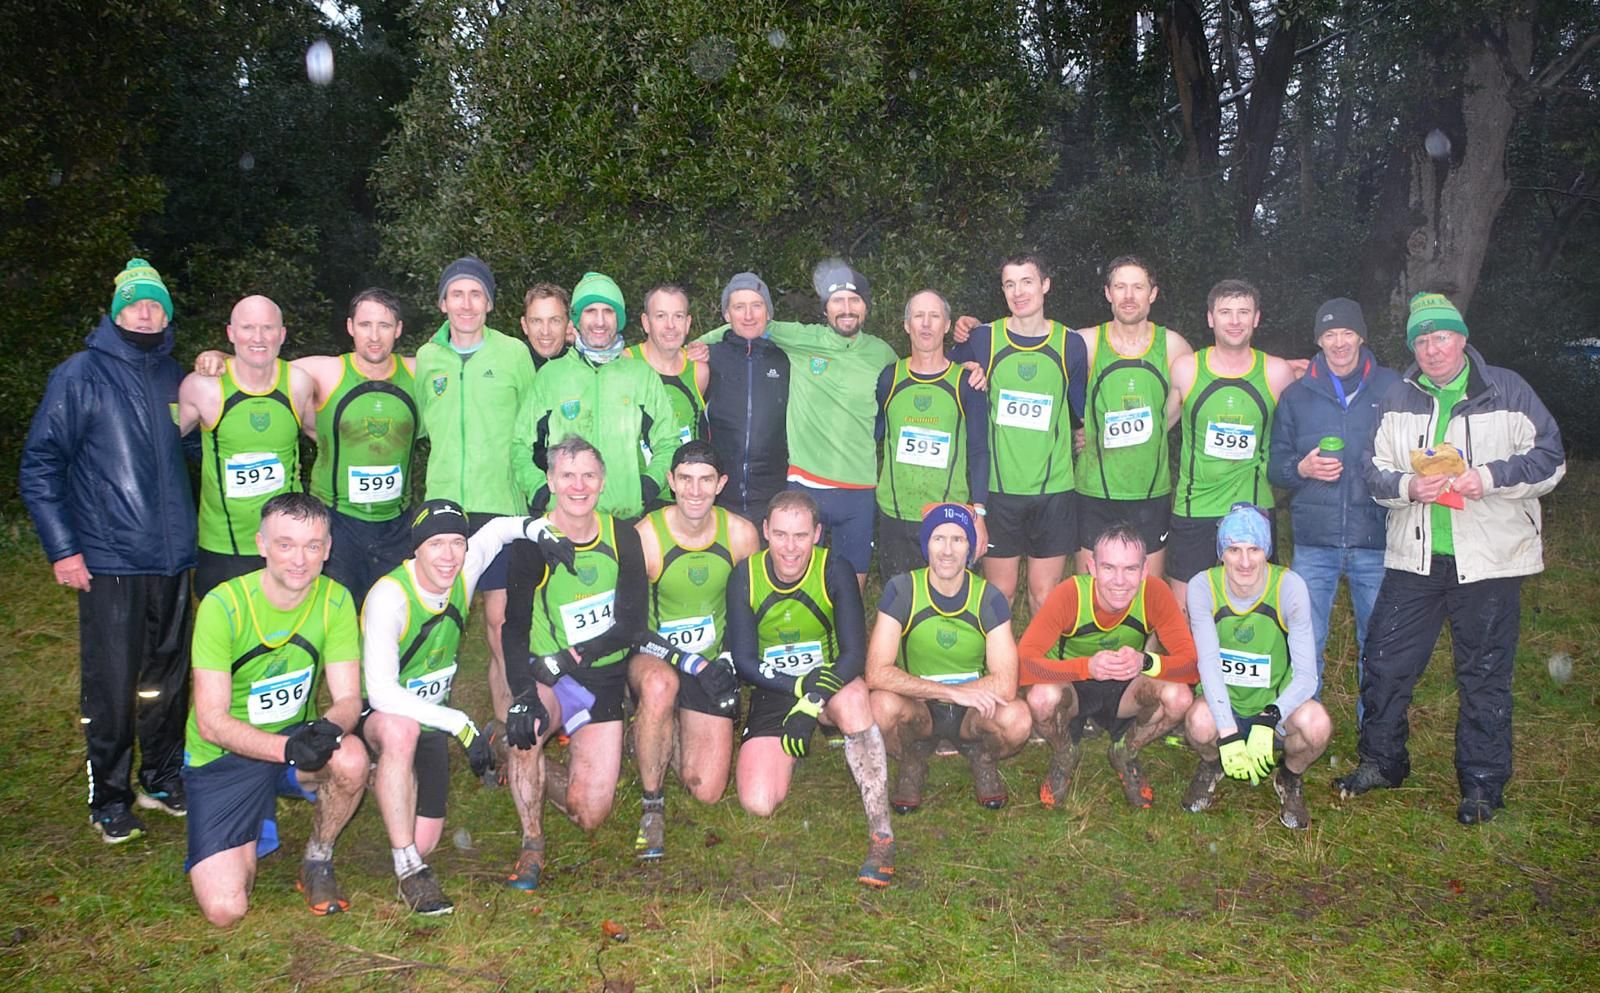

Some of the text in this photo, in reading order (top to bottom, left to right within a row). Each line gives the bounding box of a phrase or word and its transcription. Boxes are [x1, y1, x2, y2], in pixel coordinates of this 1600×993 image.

[1007, 401, 1042, 418] 609
[1109, 418, 1144, 437] 600
[905, 438, 941, 455] 595
[1214, 432, 1249, 449] 598
[236, 466, 276, 485] 592
[359, 475, 395, 491] 599
[573, 604, 611, 629] 314
[667, 626, 705, 647] 607
[774, 653, 813, 669] 593
[1221, 659, 1260, 677] 591
[259, 683, 303, 710] 596
[416, 677, 450, 699] 601
